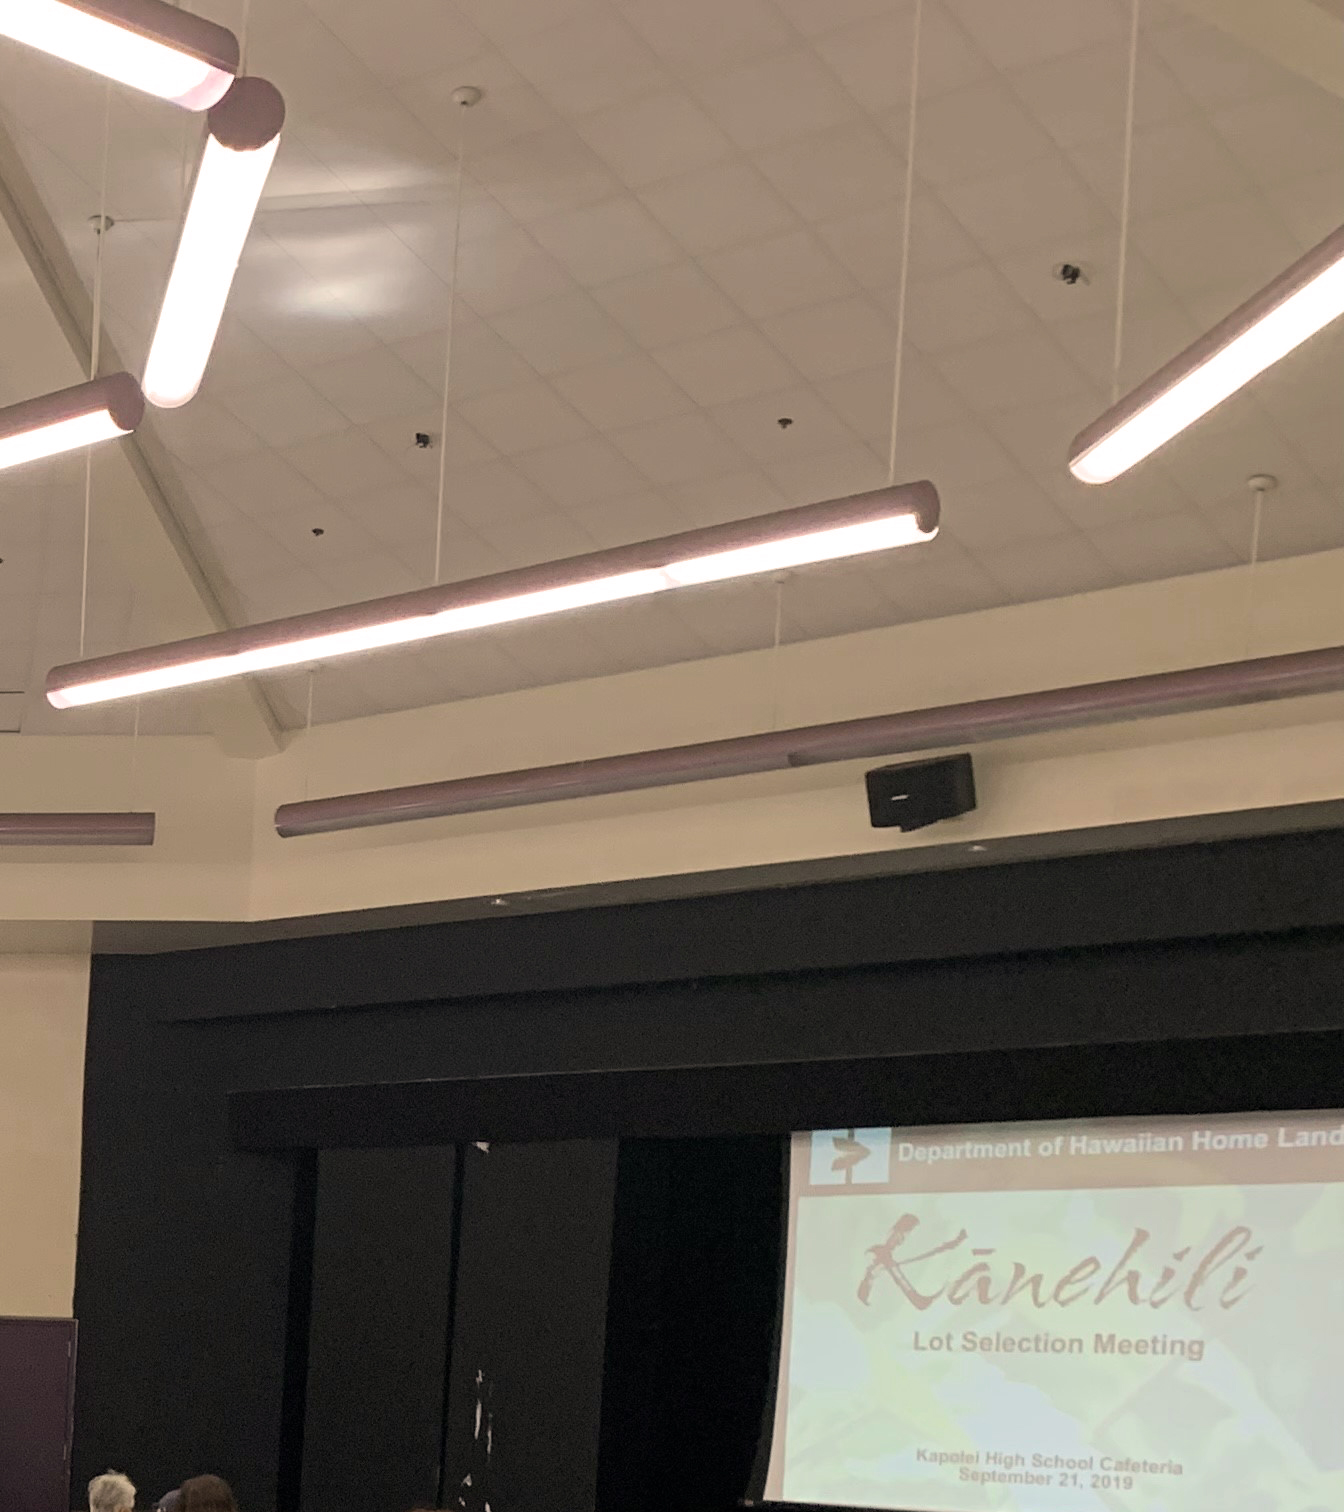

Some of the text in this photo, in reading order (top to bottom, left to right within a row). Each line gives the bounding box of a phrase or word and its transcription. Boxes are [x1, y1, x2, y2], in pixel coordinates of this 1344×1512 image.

[898, 1138, 1031, 1164] Department
[1038, 1136, 1063, 1157] of
[1069, 1132, 1184, 1156] Hawaiian
[1191, 1130, 1269, 1151] Home
[857, 1213, 1265, 1311] Kānehili
[913, 1331, 1205, 1362] Lot Selection Meeting
[916, 1448, 1183, 1476] Kapolei High School Cafeteria
[959, 1467, 1134, 1490] September 21, 2019
